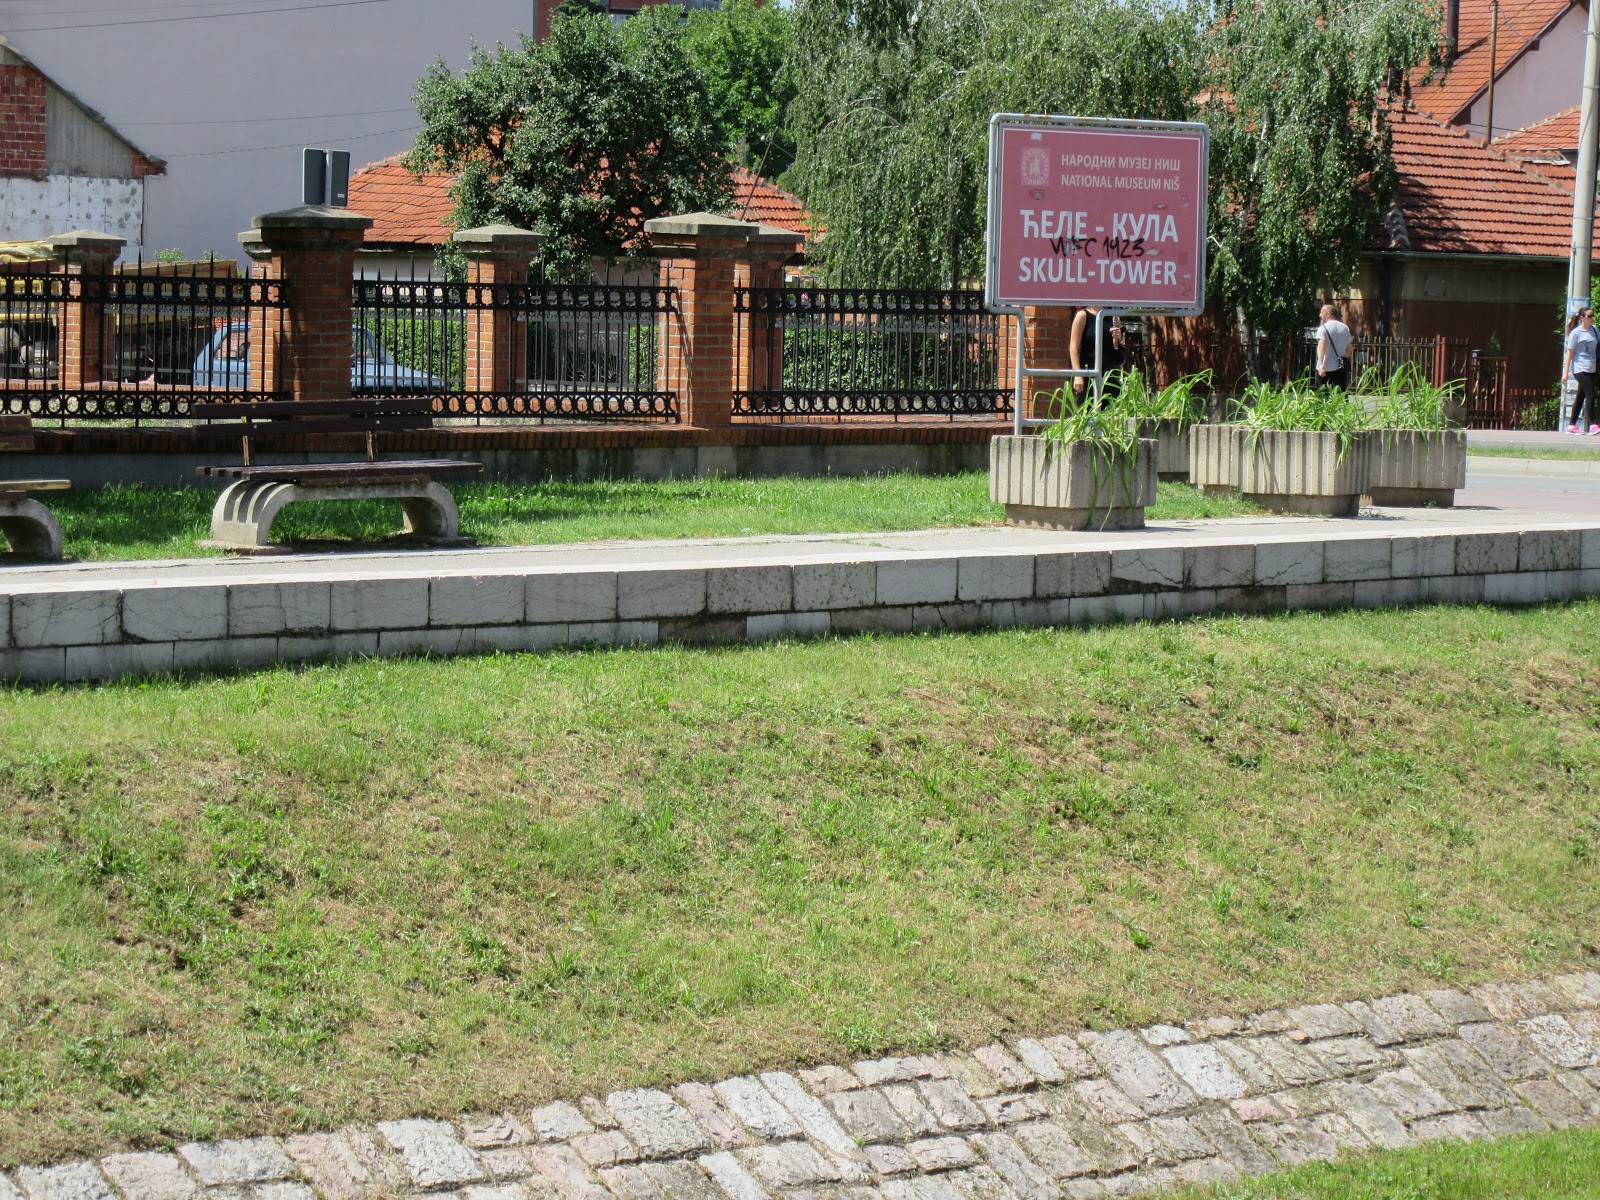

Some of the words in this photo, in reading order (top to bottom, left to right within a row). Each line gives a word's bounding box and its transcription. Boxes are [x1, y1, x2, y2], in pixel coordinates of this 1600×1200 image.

[1061, 154, 1115, 169] НАРОДНИ
[1118, 156, 1152, 170] МУЗЕЈ
[1154, 158, 1180, 171] НИШ
[1061, 174, 1113, 188] NATIONAL
[1114, 176, 1161, 190] MUSEUM
[1163, 175, 1180, 191] NIŠ
[1019, 209, 1088, 239] ЋЕЛЕ
[1112, 212, 1179, 243] КУЛА
[1103, 236, 1145, 258] 1923
[1018, 256, 1177, 286] SKULL-TOWER
